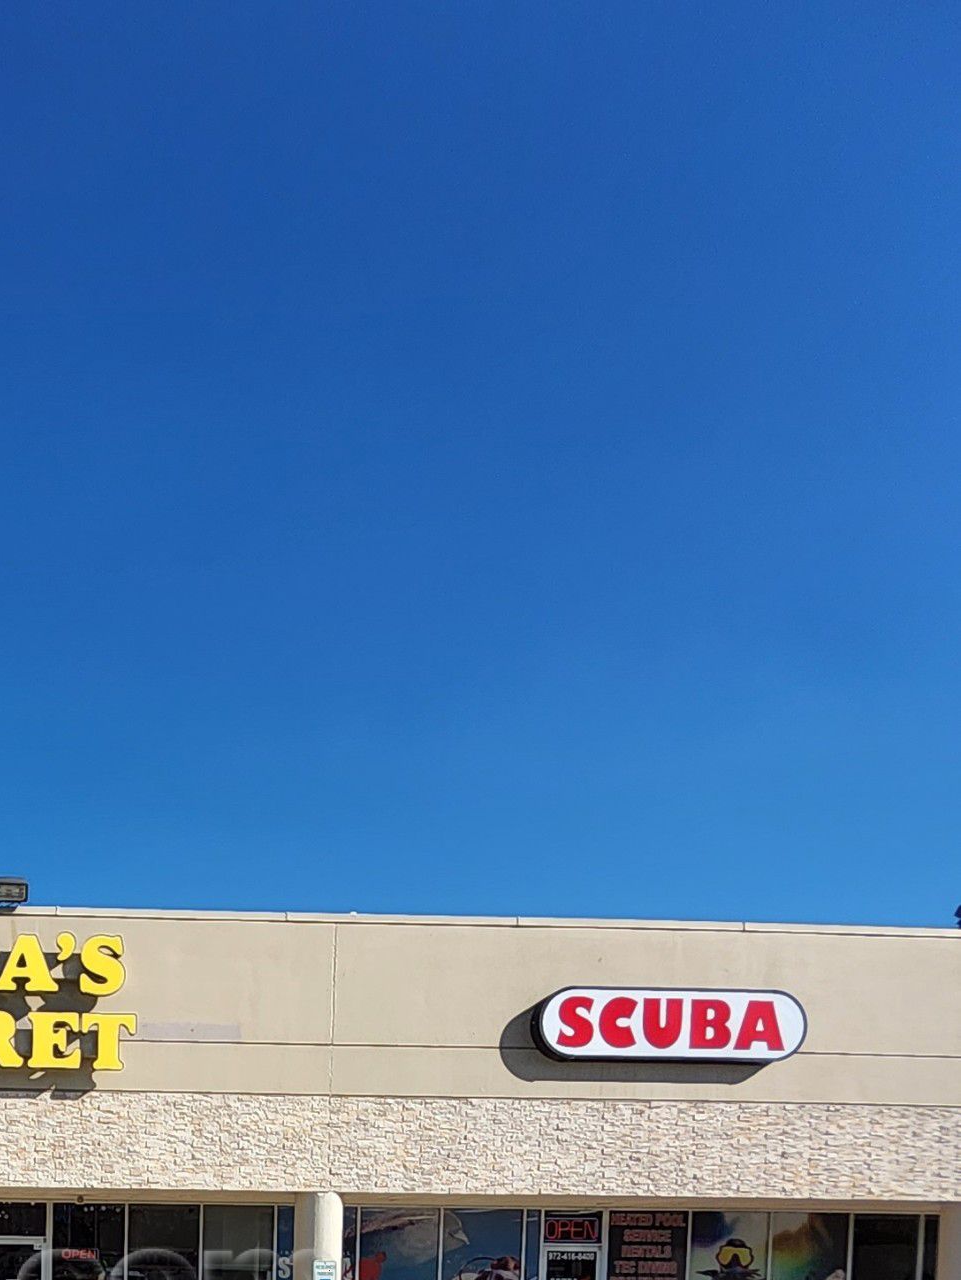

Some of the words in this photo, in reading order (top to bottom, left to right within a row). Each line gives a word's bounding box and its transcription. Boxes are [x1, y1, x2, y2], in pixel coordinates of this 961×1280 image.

[556, 996, 786, 1051] SCUBA
[611, 1213, 653, 1226] HEATED
[655, 1213, 686, 1227] POOL
[545, 1219, 597, 1241] OPEN
[623, 1229, 672, 1242] SERVICE
[62, 1248, 96, 1260] OPEN
[621, 1245, 672, 1258] RENTALS
[613, 1261, 636, 1274] TEC
[638, 1261, 677, 1274] DIVING
